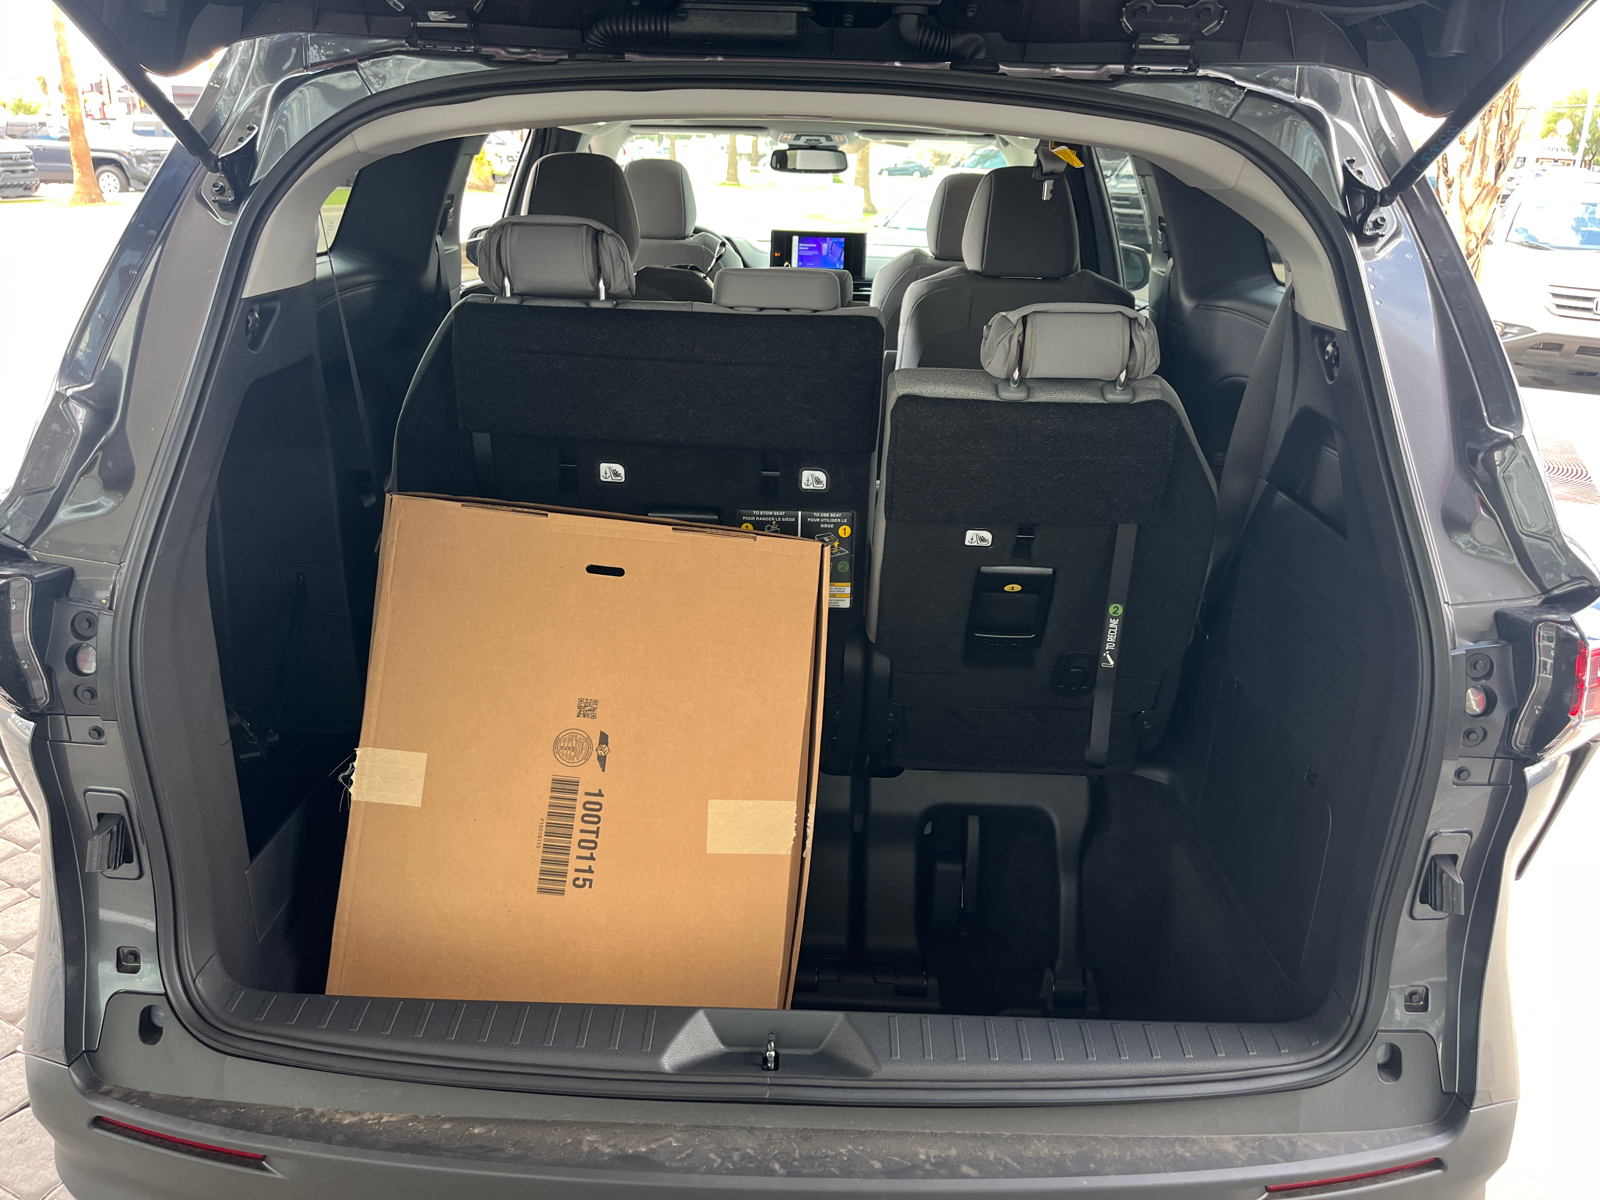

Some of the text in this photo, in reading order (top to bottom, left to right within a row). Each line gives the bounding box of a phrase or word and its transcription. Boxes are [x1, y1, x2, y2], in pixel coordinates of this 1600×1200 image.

[1112, 606, 1119, 614] 2
[1107, 618, 1119, 642] RECLINE
[572, 788, 605, 889] 100T0115
